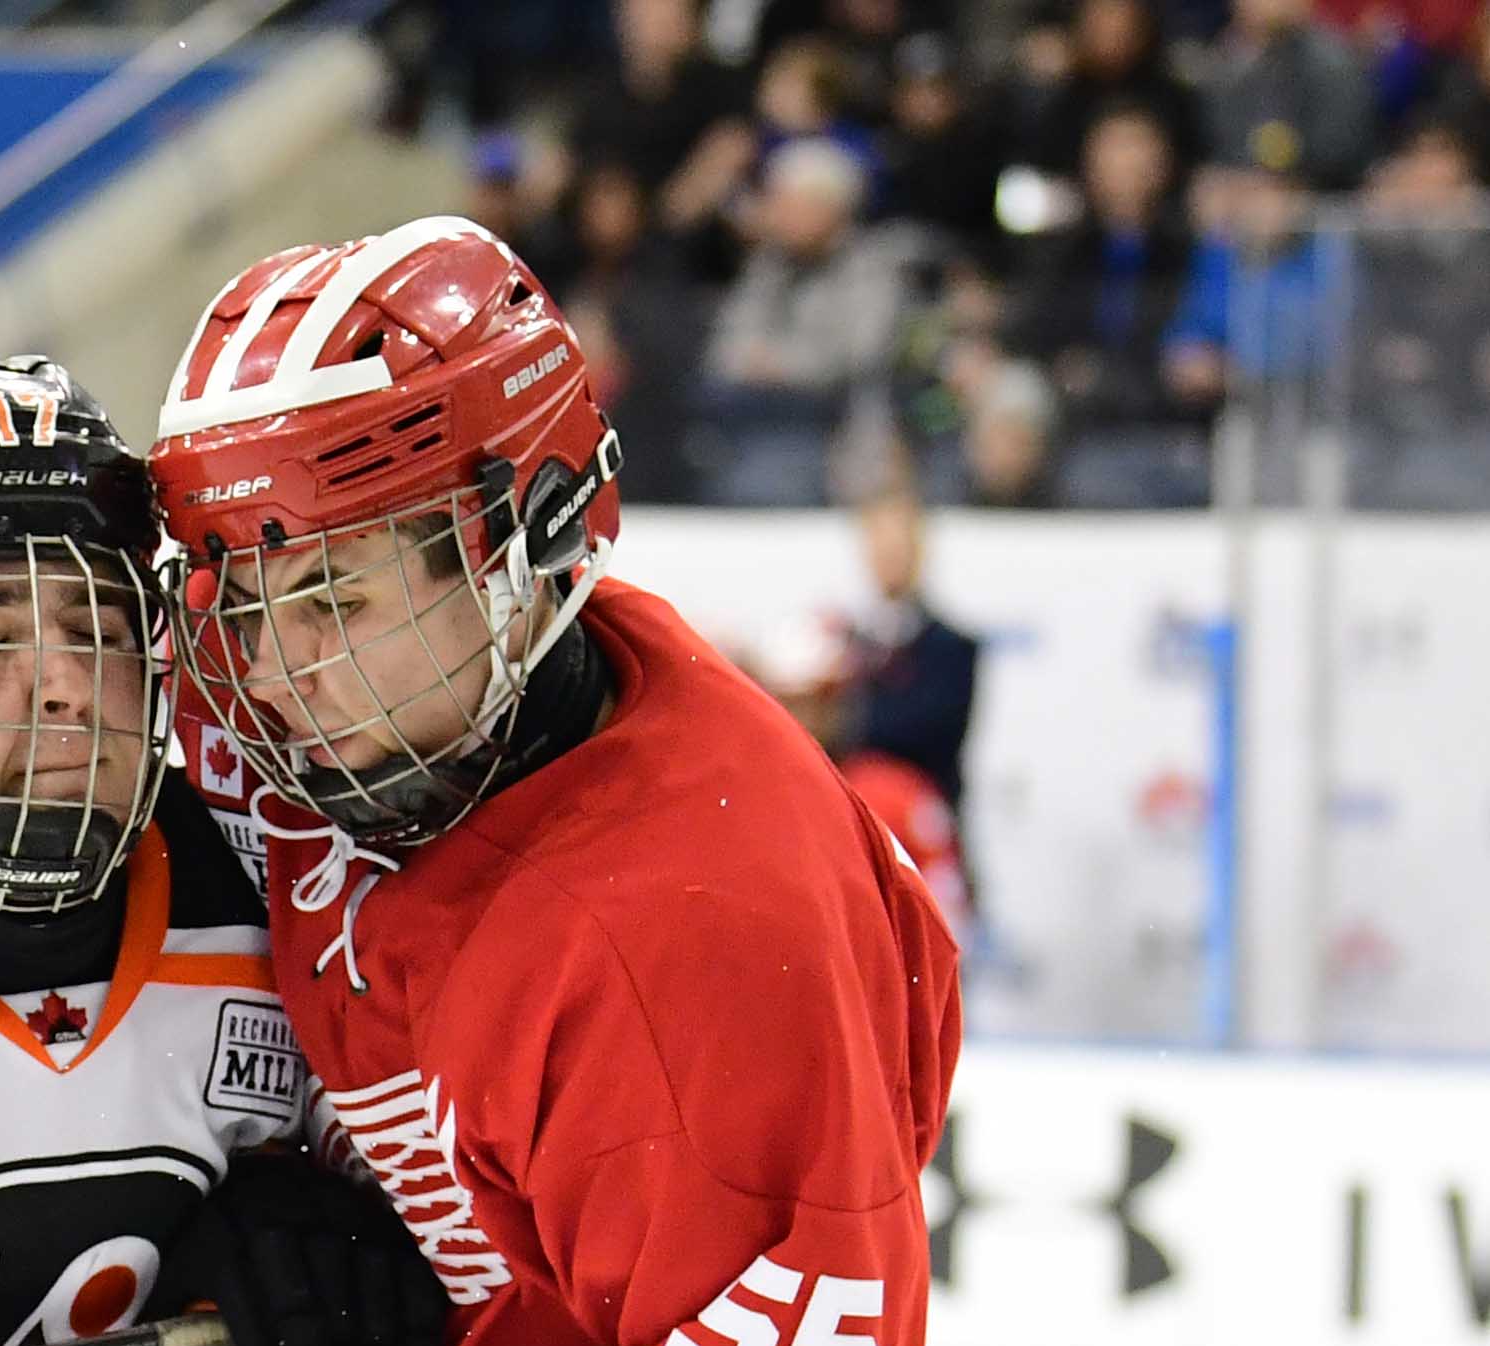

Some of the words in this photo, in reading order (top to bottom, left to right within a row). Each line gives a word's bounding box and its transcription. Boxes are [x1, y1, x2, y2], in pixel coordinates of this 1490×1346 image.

[502, 342, 571, 400] BAUER
[546, 473, 597, 539] BAUER
[228, 1014, 300, 1050] RECHAR
